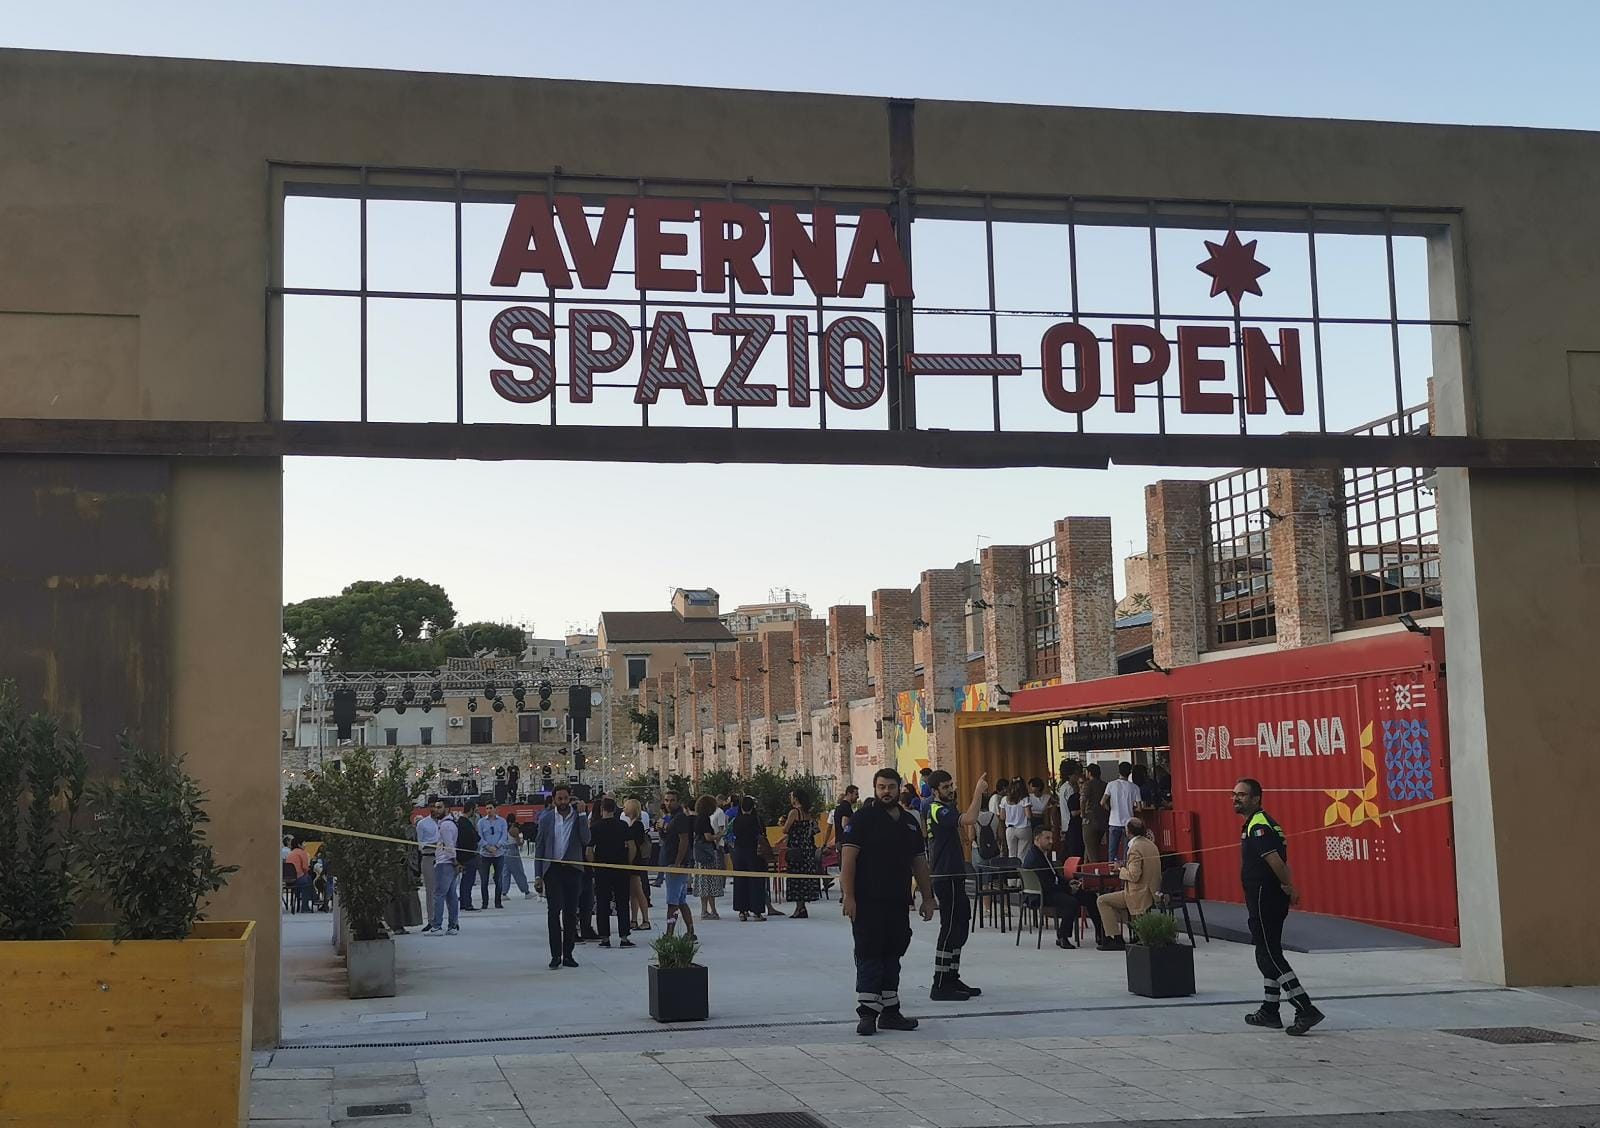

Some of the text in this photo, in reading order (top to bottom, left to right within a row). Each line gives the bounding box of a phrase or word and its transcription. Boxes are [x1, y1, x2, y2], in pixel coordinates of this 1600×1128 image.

[490, 194, 915, 299] AVERNA
[489, 305, 1305, 416] SPAZIO OPEN
[1194, 716, 1346, 761] BAR AVERNA
